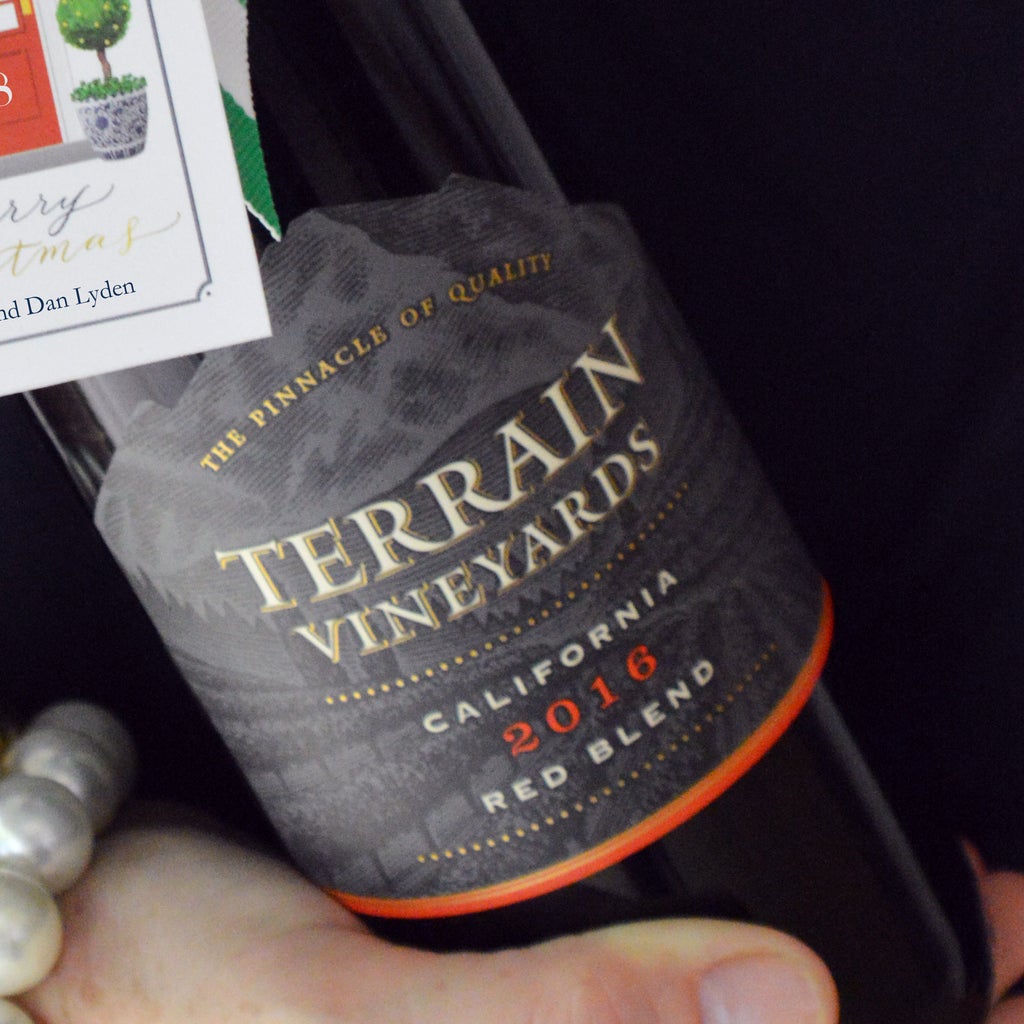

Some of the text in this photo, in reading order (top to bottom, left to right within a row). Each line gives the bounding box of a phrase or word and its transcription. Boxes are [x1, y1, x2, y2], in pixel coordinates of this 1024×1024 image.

[26, 292, 69, 317] Dan
[75, 280, 136, 308] Lyden
[200, 252, 553, 476] THE PINNACLE OF QUALITY
[214, 315, 645, 613] TERRAIN
[292, 418, 662, 664] VINEYARDS
[422, 569, 679, 733] CALIFORNIA
[502, 644, 658, 758] 2016
[480, 659, 715, 813] RED BLEND
